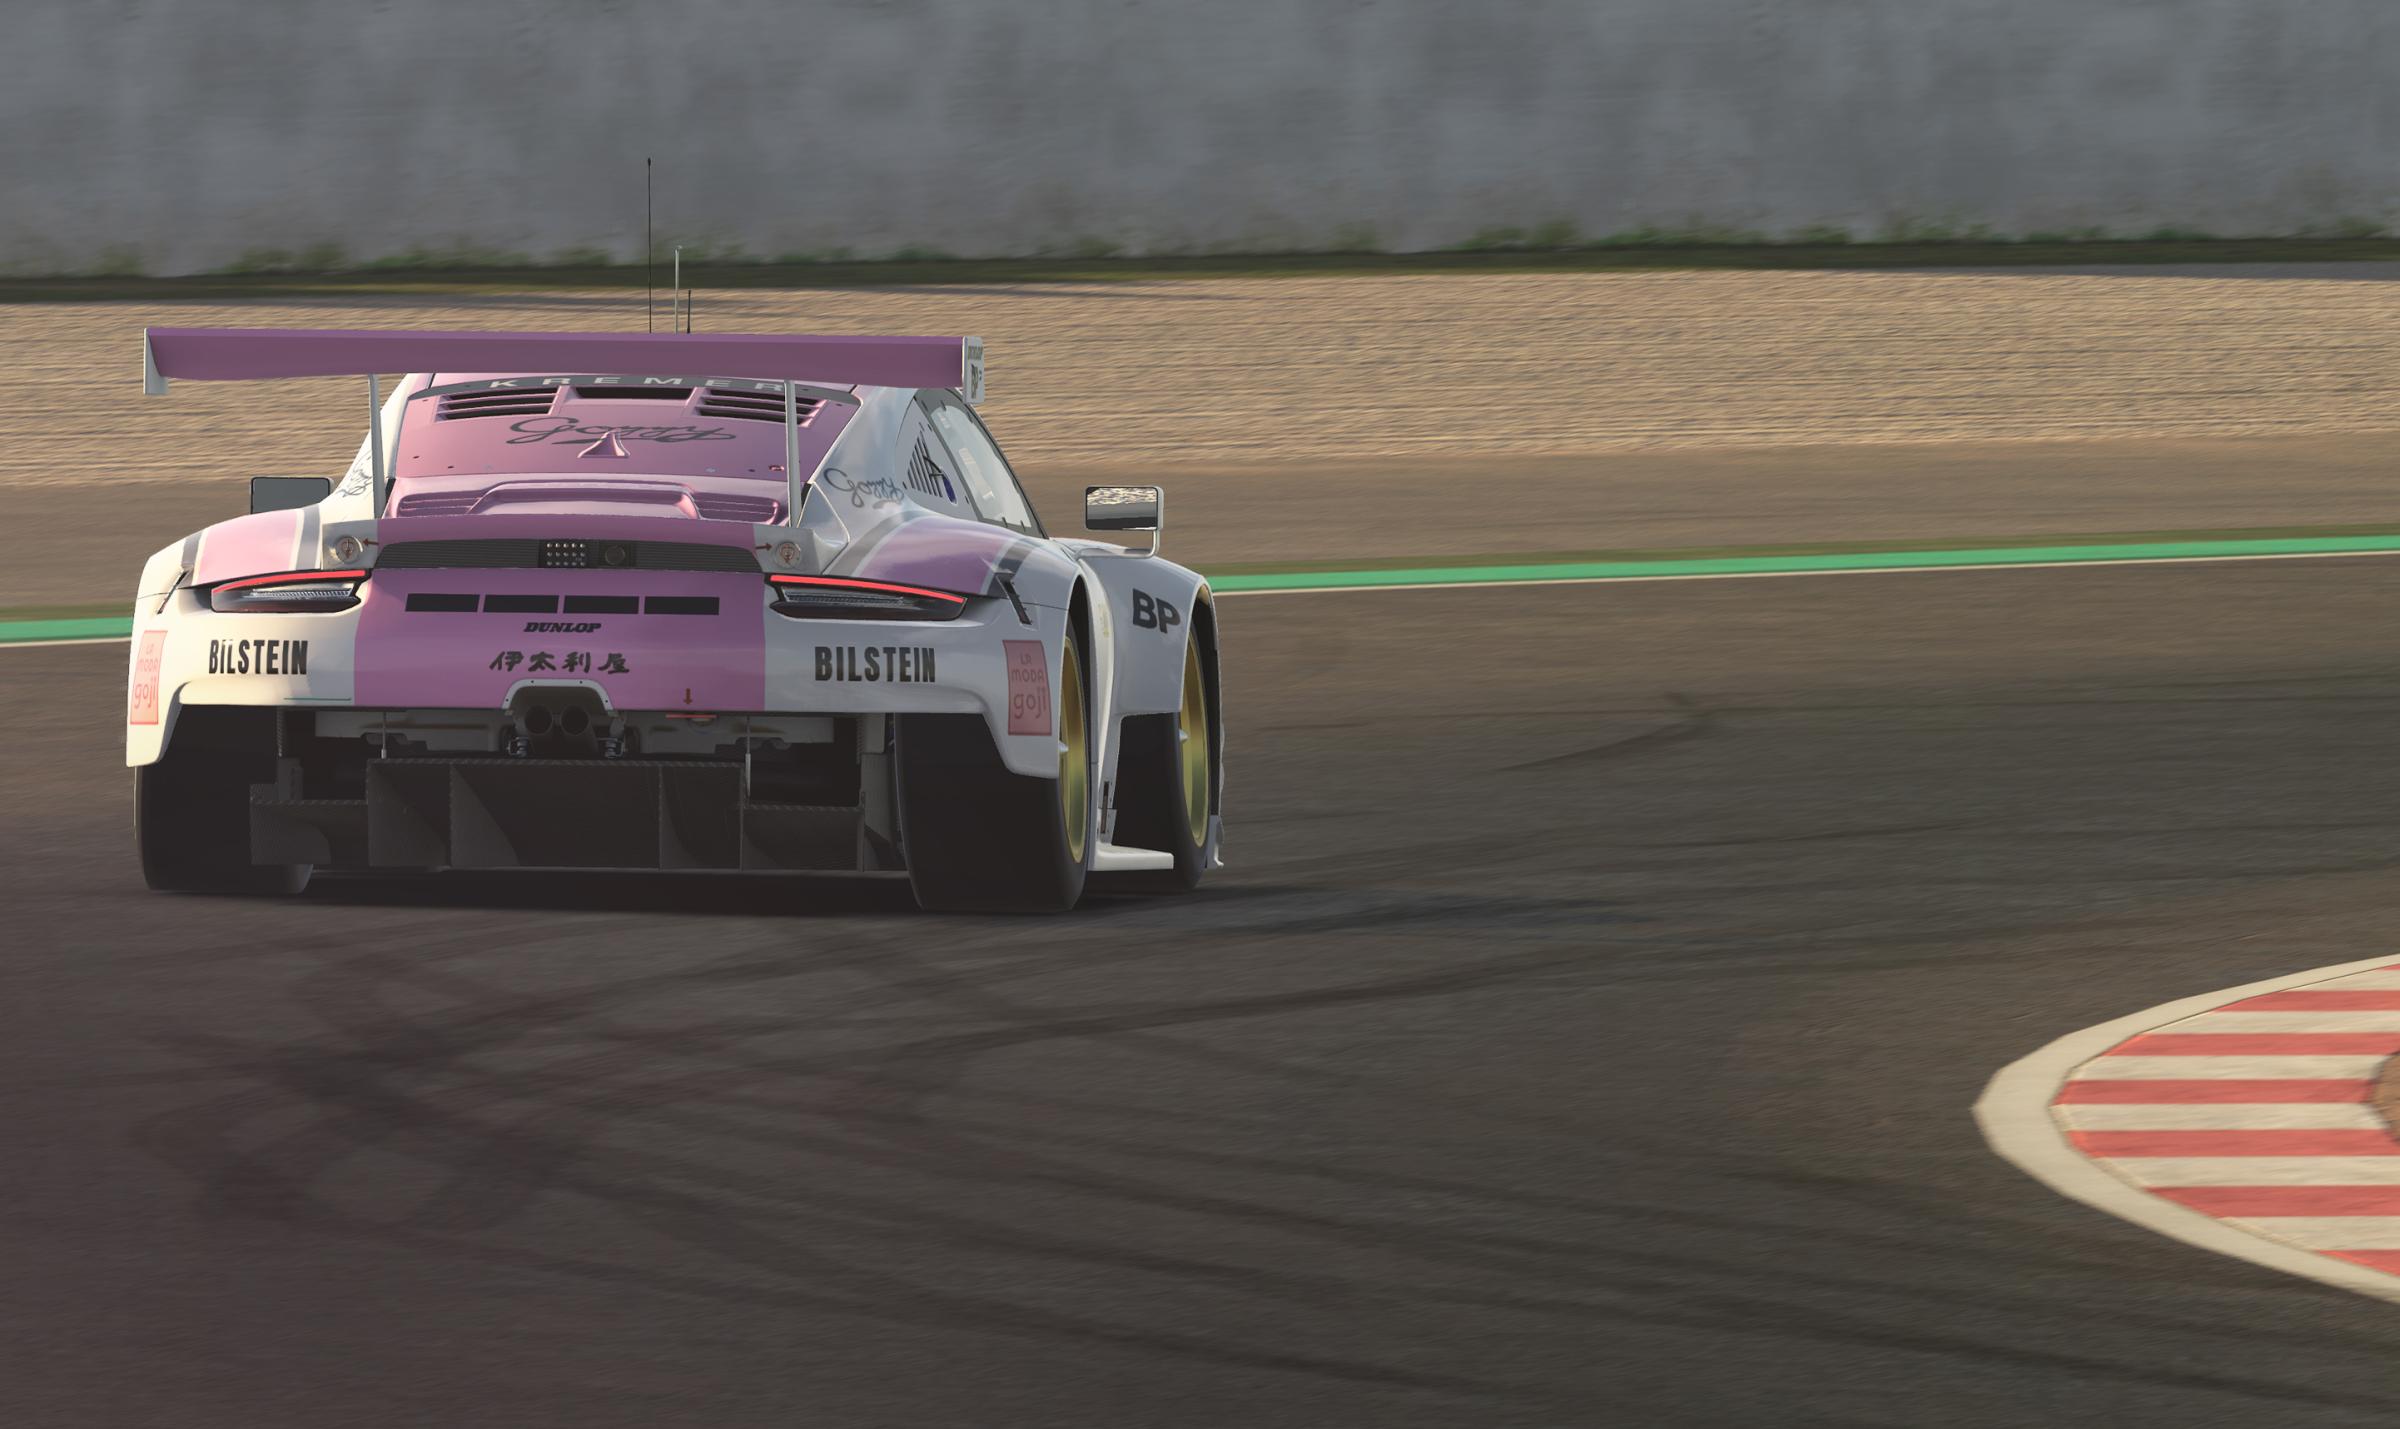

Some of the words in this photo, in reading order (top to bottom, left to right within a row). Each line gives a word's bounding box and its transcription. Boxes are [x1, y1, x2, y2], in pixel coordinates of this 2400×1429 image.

[489, 376, 786, 392] KREMER
[523, 622, 602, 633] DUNLOP
[1132, 588, 1181, 634] BP
[208, 639, 308, 675] BILSTEIN
[489, 651, 630, 674] 伊太利屋
[814, 646, 936, 682] BILSTEIN
[1013, 686, 1047, 719] goji
